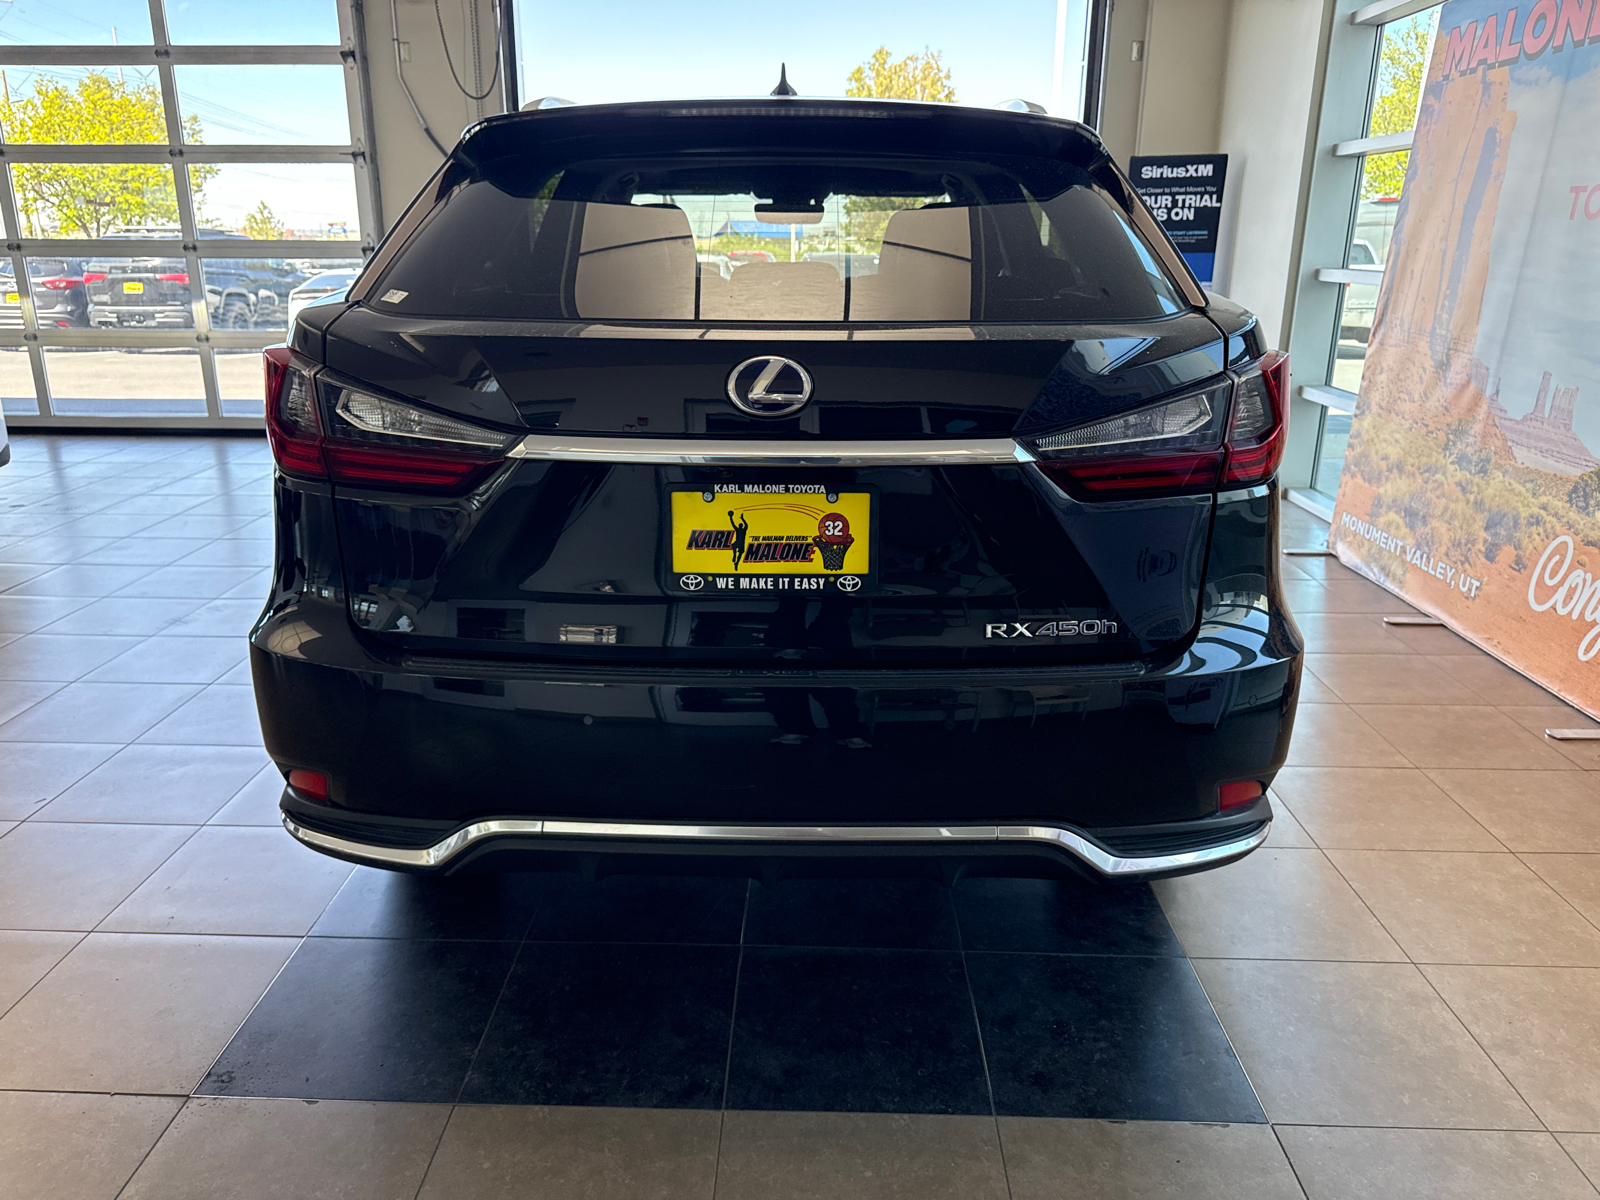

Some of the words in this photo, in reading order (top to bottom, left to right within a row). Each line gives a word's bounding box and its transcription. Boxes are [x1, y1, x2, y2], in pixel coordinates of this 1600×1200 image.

[1141, 164, 1214, 179] SiriusXM
[1147, 186, 1164, 194] Closer
[1186, 185, 1205, 193] Moves
[1142, 195, 1172, 208] OUR
[1175, 194, 1221, 208] TRIAL
[1170, 208, 1194, 221] ON
[714, 484, 742, 493] KARL
[744, 484, 786, 494] MALONE
[788, 484, 826, 494] TOYOTA
[824, 520, 843, 536] 32
[686, 529, 735, 550] KARL
[743, 542, 816, 563] MALONE
[1341, 511, 1404, 556] MONUMENT
[1406, 544, 1456, 589] VALLEY,
[1458, 573, 1480, 598] UT
[716, 577, 735, 589] WE
[740, 577, 774, 589] MAKE
[779, 577, 790, 589] IT
[794, 577, 826, 590] EASY
